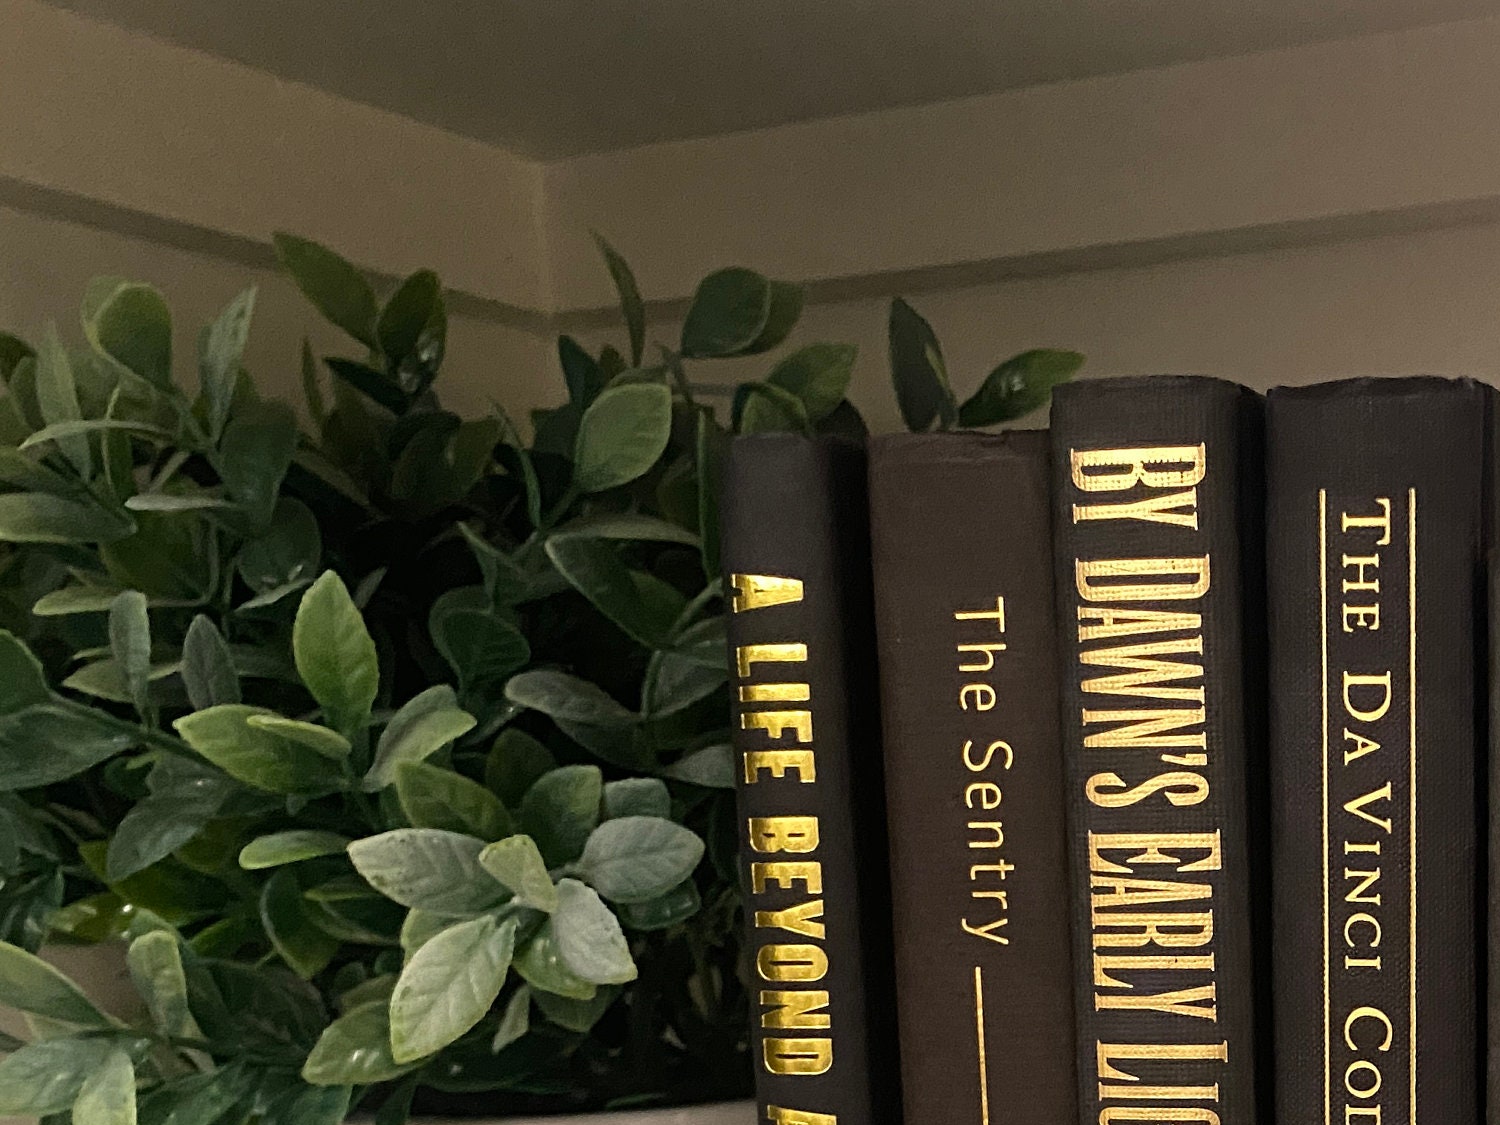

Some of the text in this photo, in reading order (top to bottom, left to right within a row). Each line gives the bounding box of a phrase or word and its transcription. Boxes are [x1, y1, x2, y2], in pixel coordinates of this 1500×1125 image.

[1071, 442, 1206, 531] BY
[1342, 498, 1390, 632] THE
[732, 574, 803, 613] A
[737, 643, 816, 783] LIFE
[1075, 554, 1210, 807] DAWN'S
[1343, 671, 1391, 766] DA
[955, 596, 1014, 944] The Sentry
[749, 816, 833, 1075] BEYOND
[1088, 829, 1221, 1022] EARLY
[1344, 781, 1391, 970] VINCI
